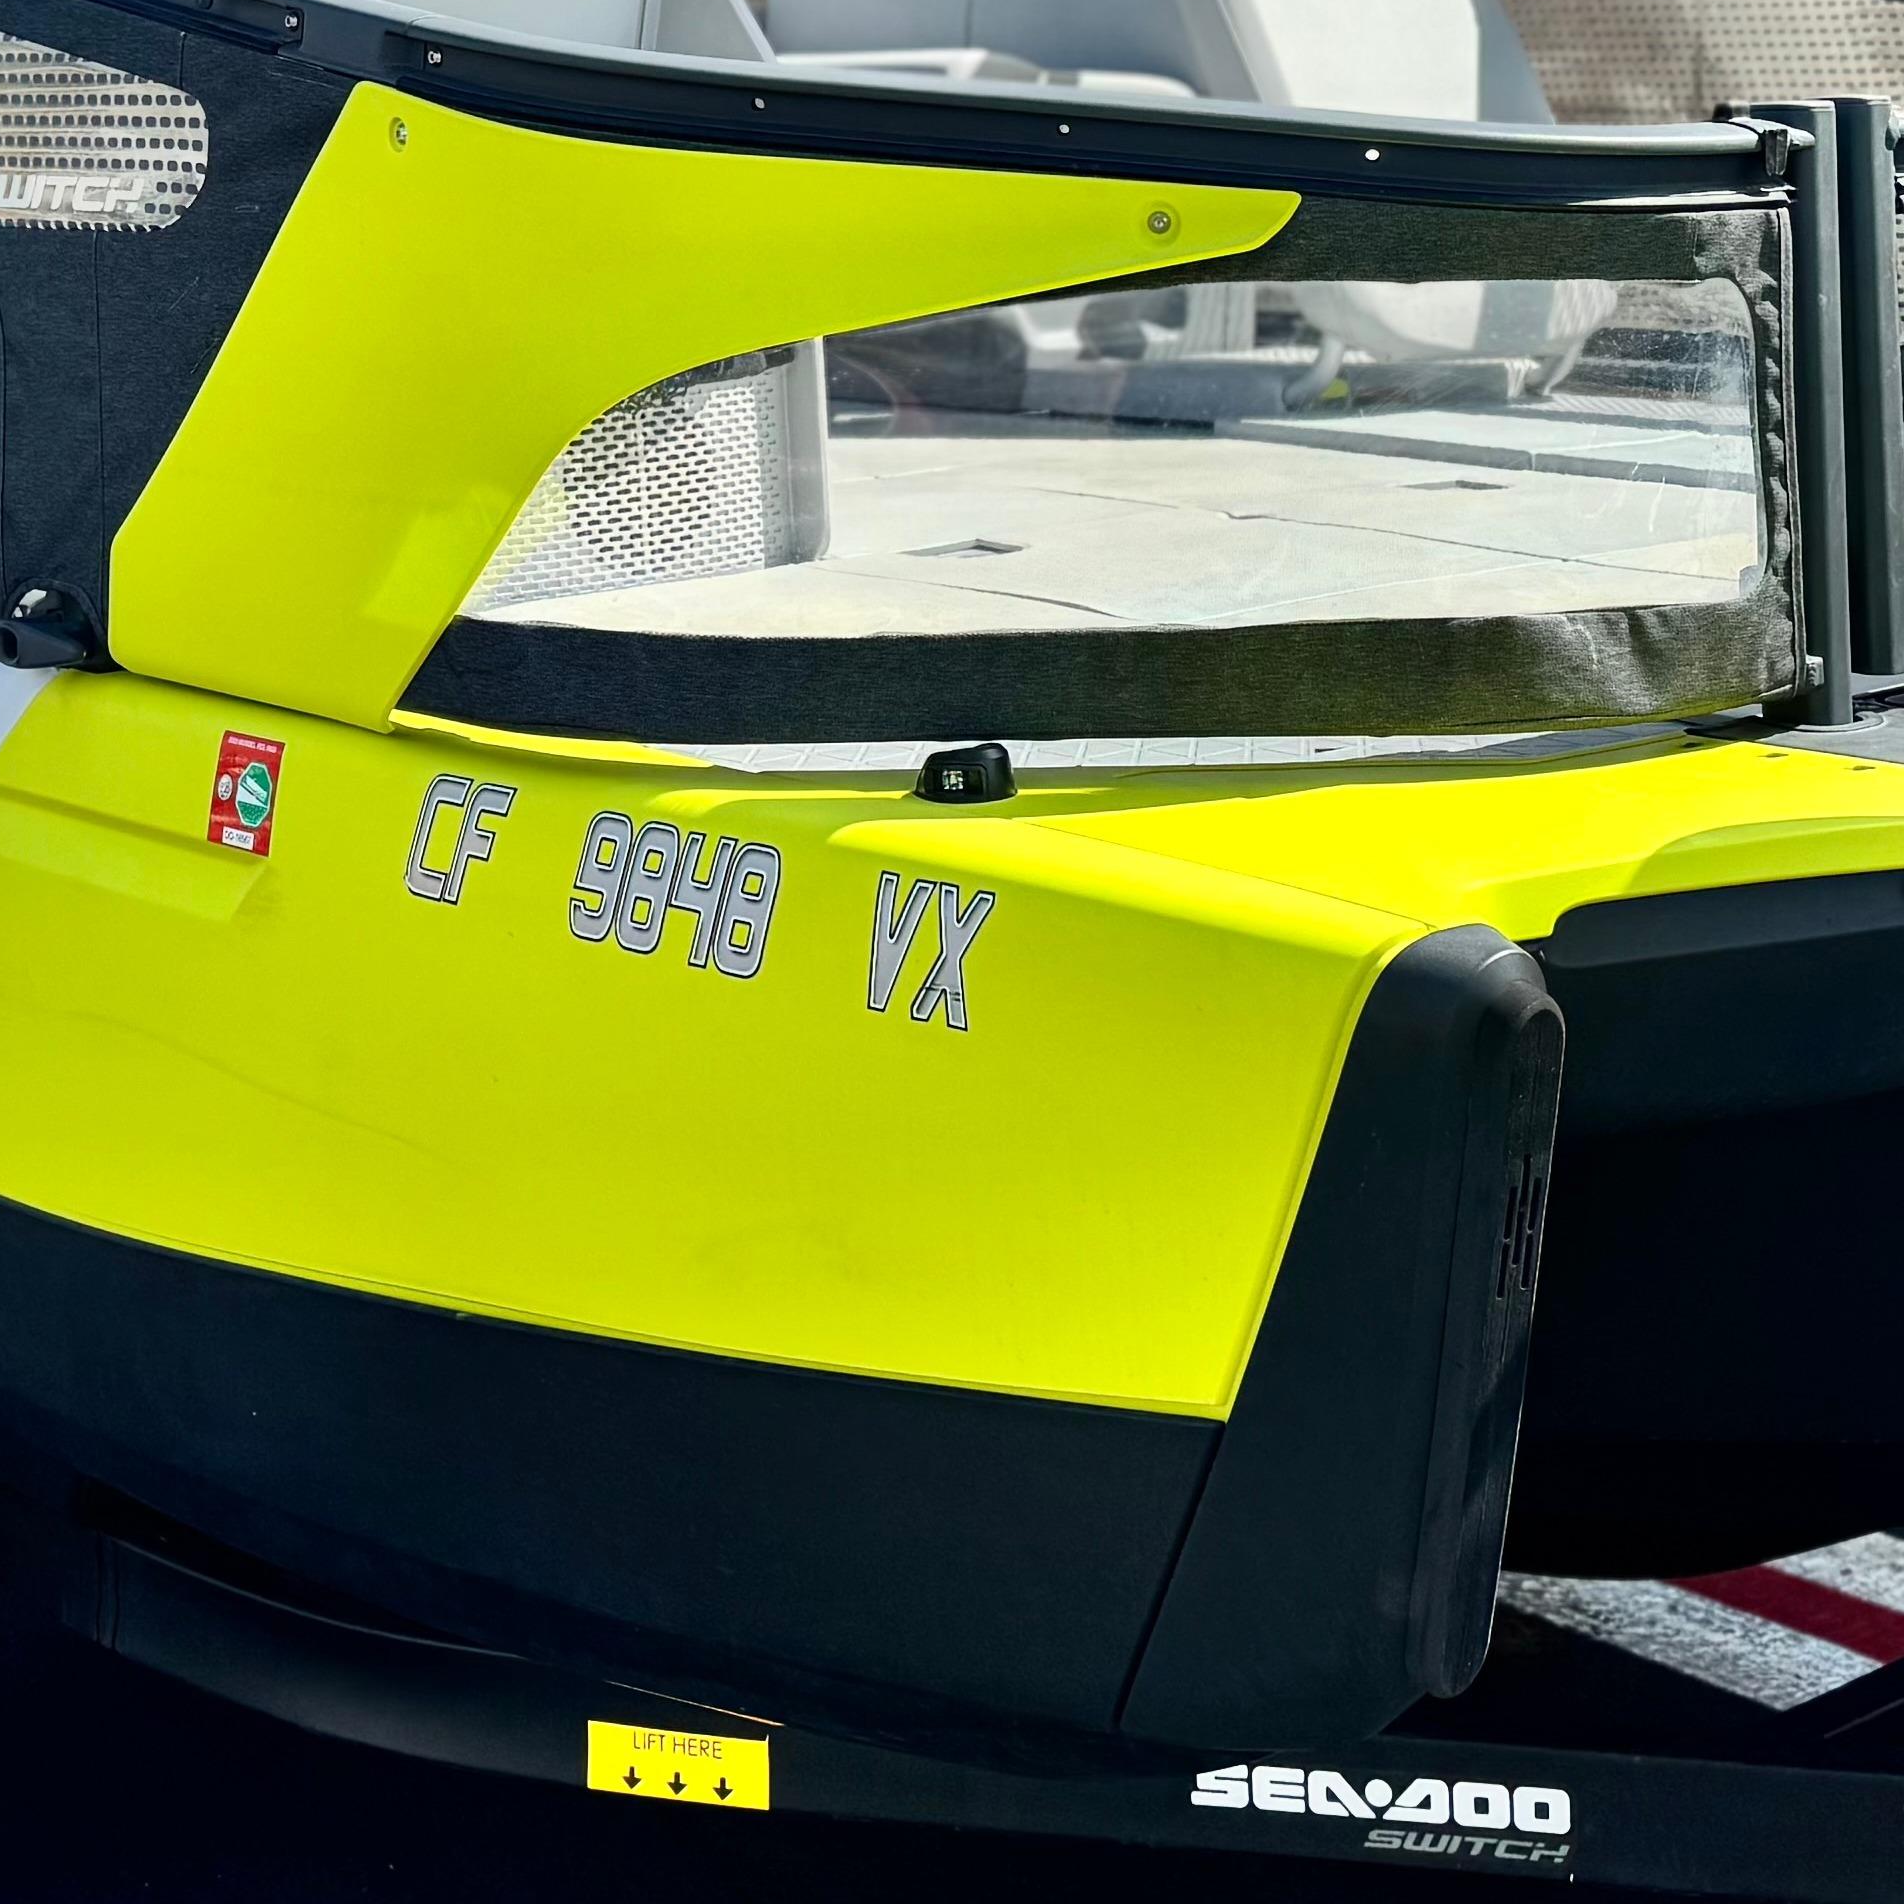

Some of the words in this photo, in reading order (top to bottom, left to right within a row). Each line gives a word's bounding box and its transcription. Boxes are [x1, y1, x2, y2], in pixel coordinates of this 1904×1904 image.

[403, 772, 519, 906] CF
[568, 809, 782, 980] 9848
[865, 869, 997, 1033] VX
[633, 1730, 666, 1753] LIFT
[672, 1736, 723, 1760] HERE
[1363, 1828, 1571, 1864] SWITCH
